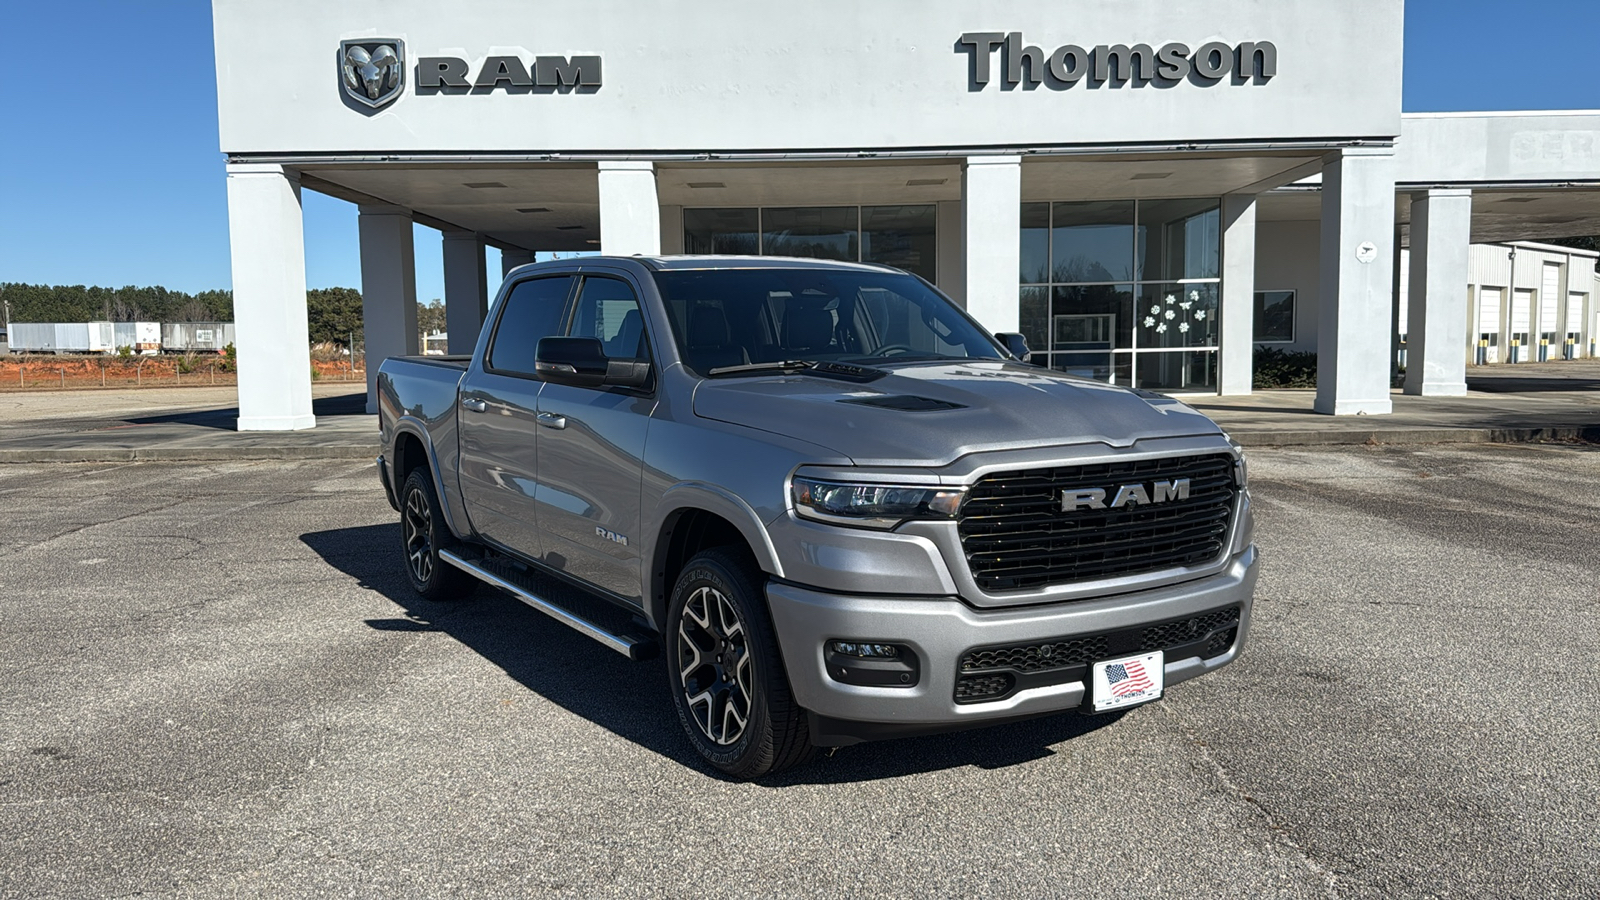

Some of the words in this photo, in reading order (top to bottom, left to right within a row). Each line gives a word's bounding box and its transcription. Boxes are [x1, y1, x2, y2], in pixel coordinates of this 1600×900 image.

[414, 56, 602, 92] RAM
[955, 32, 1277, 91] Thomson
[1061, 478, 1190, 512] RAM
[595, 526, 628, 546] RAM
[1121, 690, 1145, 699] THOMSON
